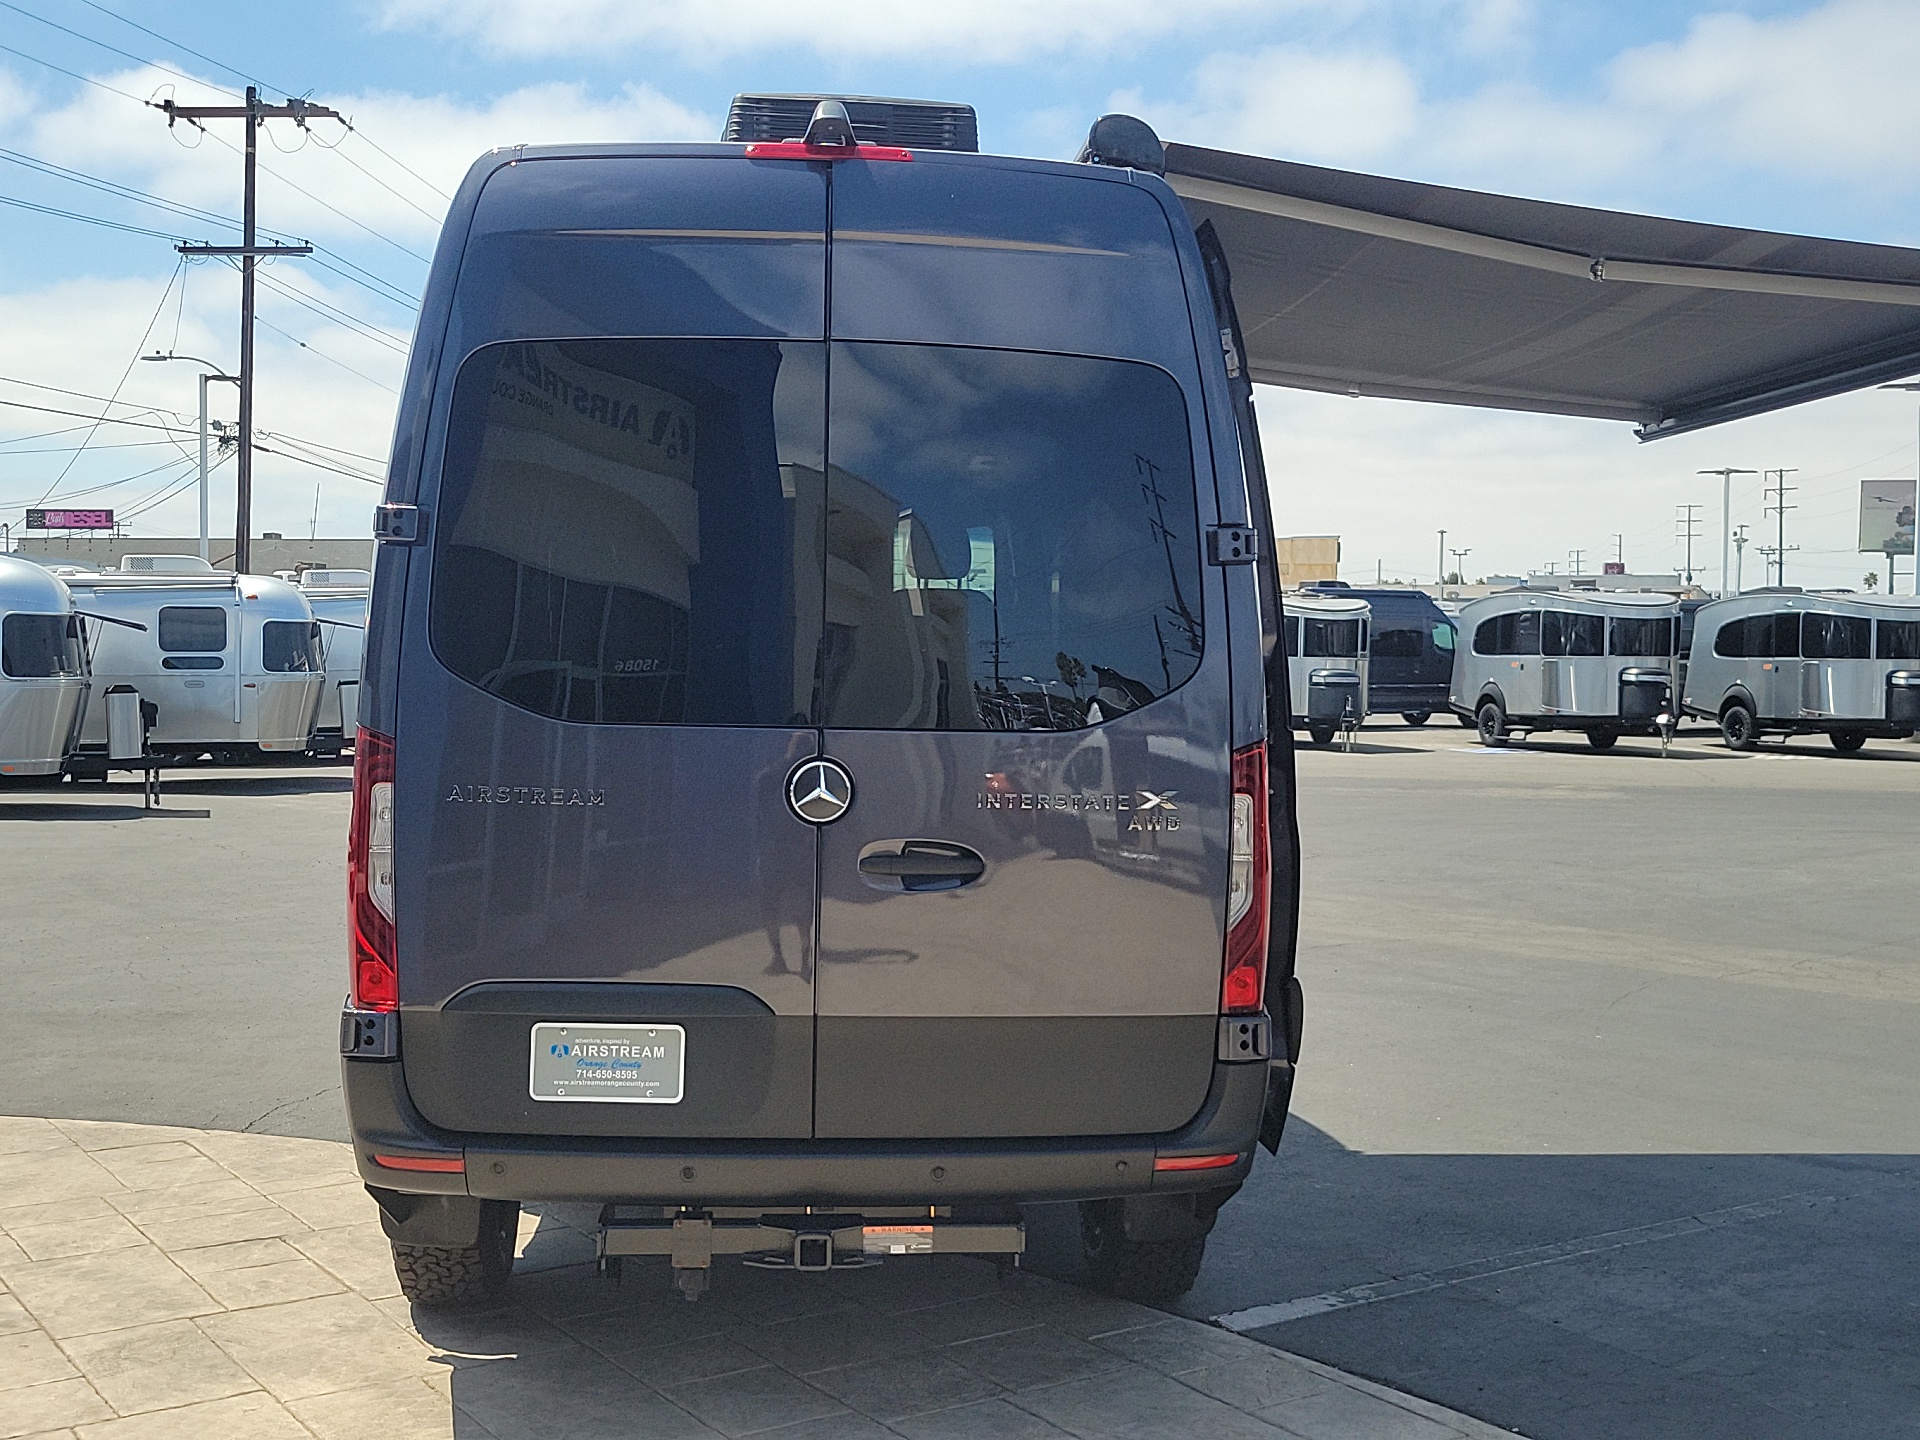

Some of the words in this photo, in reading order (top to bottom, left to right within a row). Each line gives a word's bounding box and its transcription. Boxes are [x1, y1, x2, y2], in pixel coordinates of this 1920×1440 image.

[446, 784, 605, 806] AIRSTREAM
[976, 792, 1130, 811] INTERSTATE
[1127, 815, 1181, 832] AWD
[571, 1044, 665, 1058] AIRSTREAM
[576, 1058, 608, 1069] Orange
[611, 1059, 643, 1070] County
[576, 1069, 638, 1079] 714-650-8595
[553, 1079, 660, 1087] www.airstreamorangecounty.com
